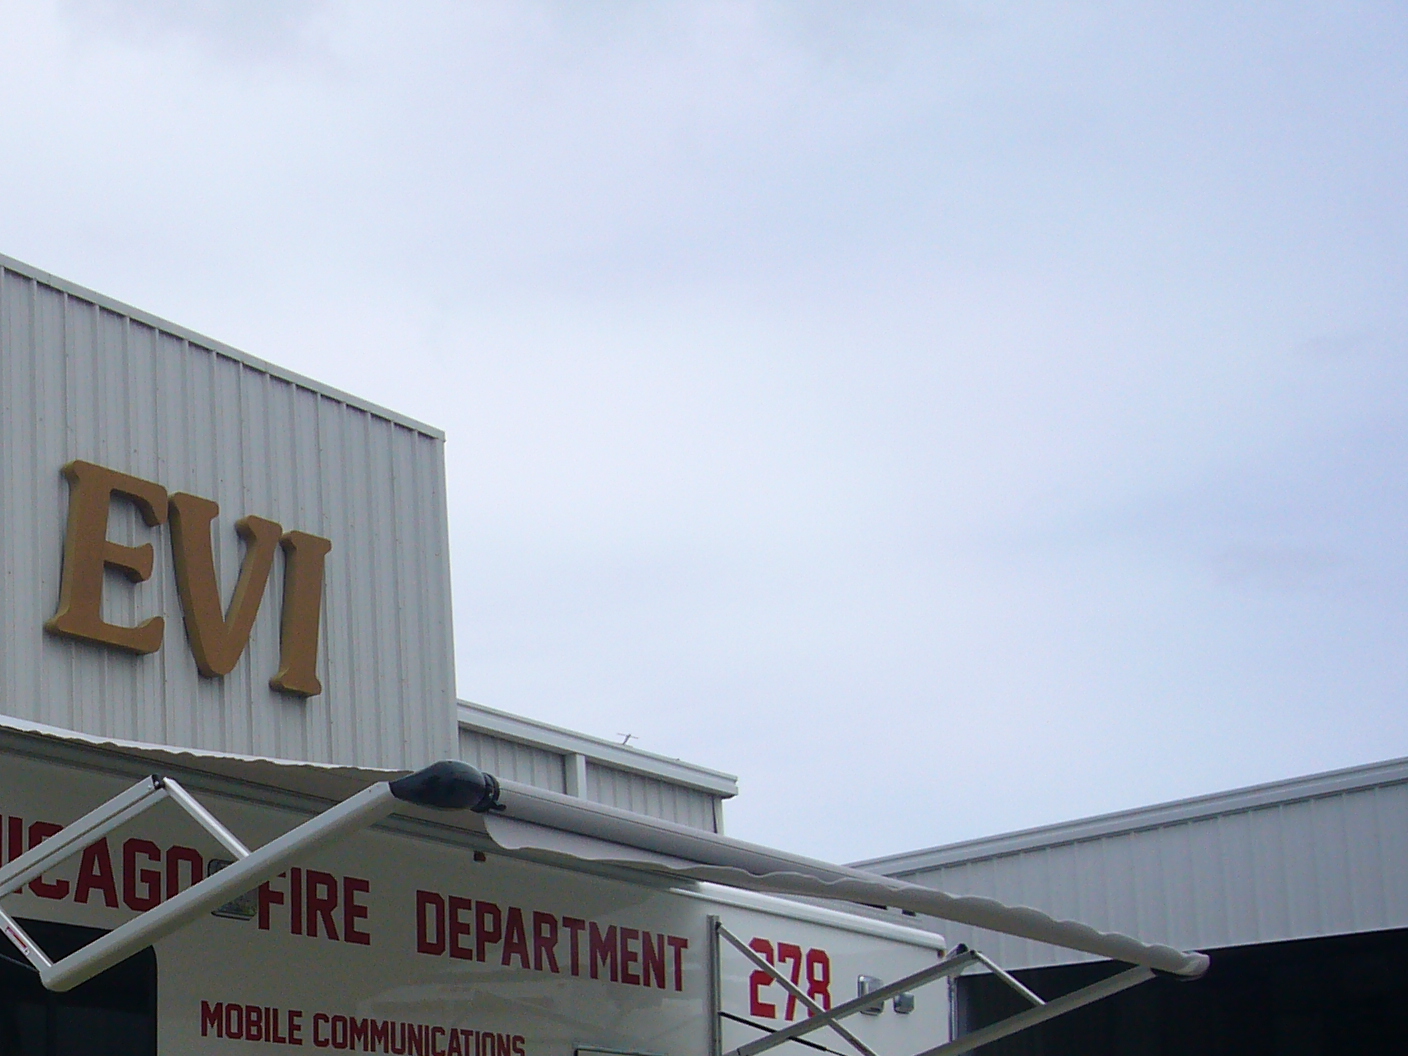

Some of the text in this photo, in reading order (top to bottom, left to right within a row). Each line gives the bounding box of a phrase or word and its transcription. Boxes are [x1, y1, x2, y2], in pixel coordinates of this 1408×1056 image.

[43, 459, 332, 697] EVI
[257, 866, 371, 946] FIRE
[415, 889, 689, 992] DEPARTMENT
[748, 937, 832, 1022] 278
[200, 1000, 304, 1046] MOBILE
